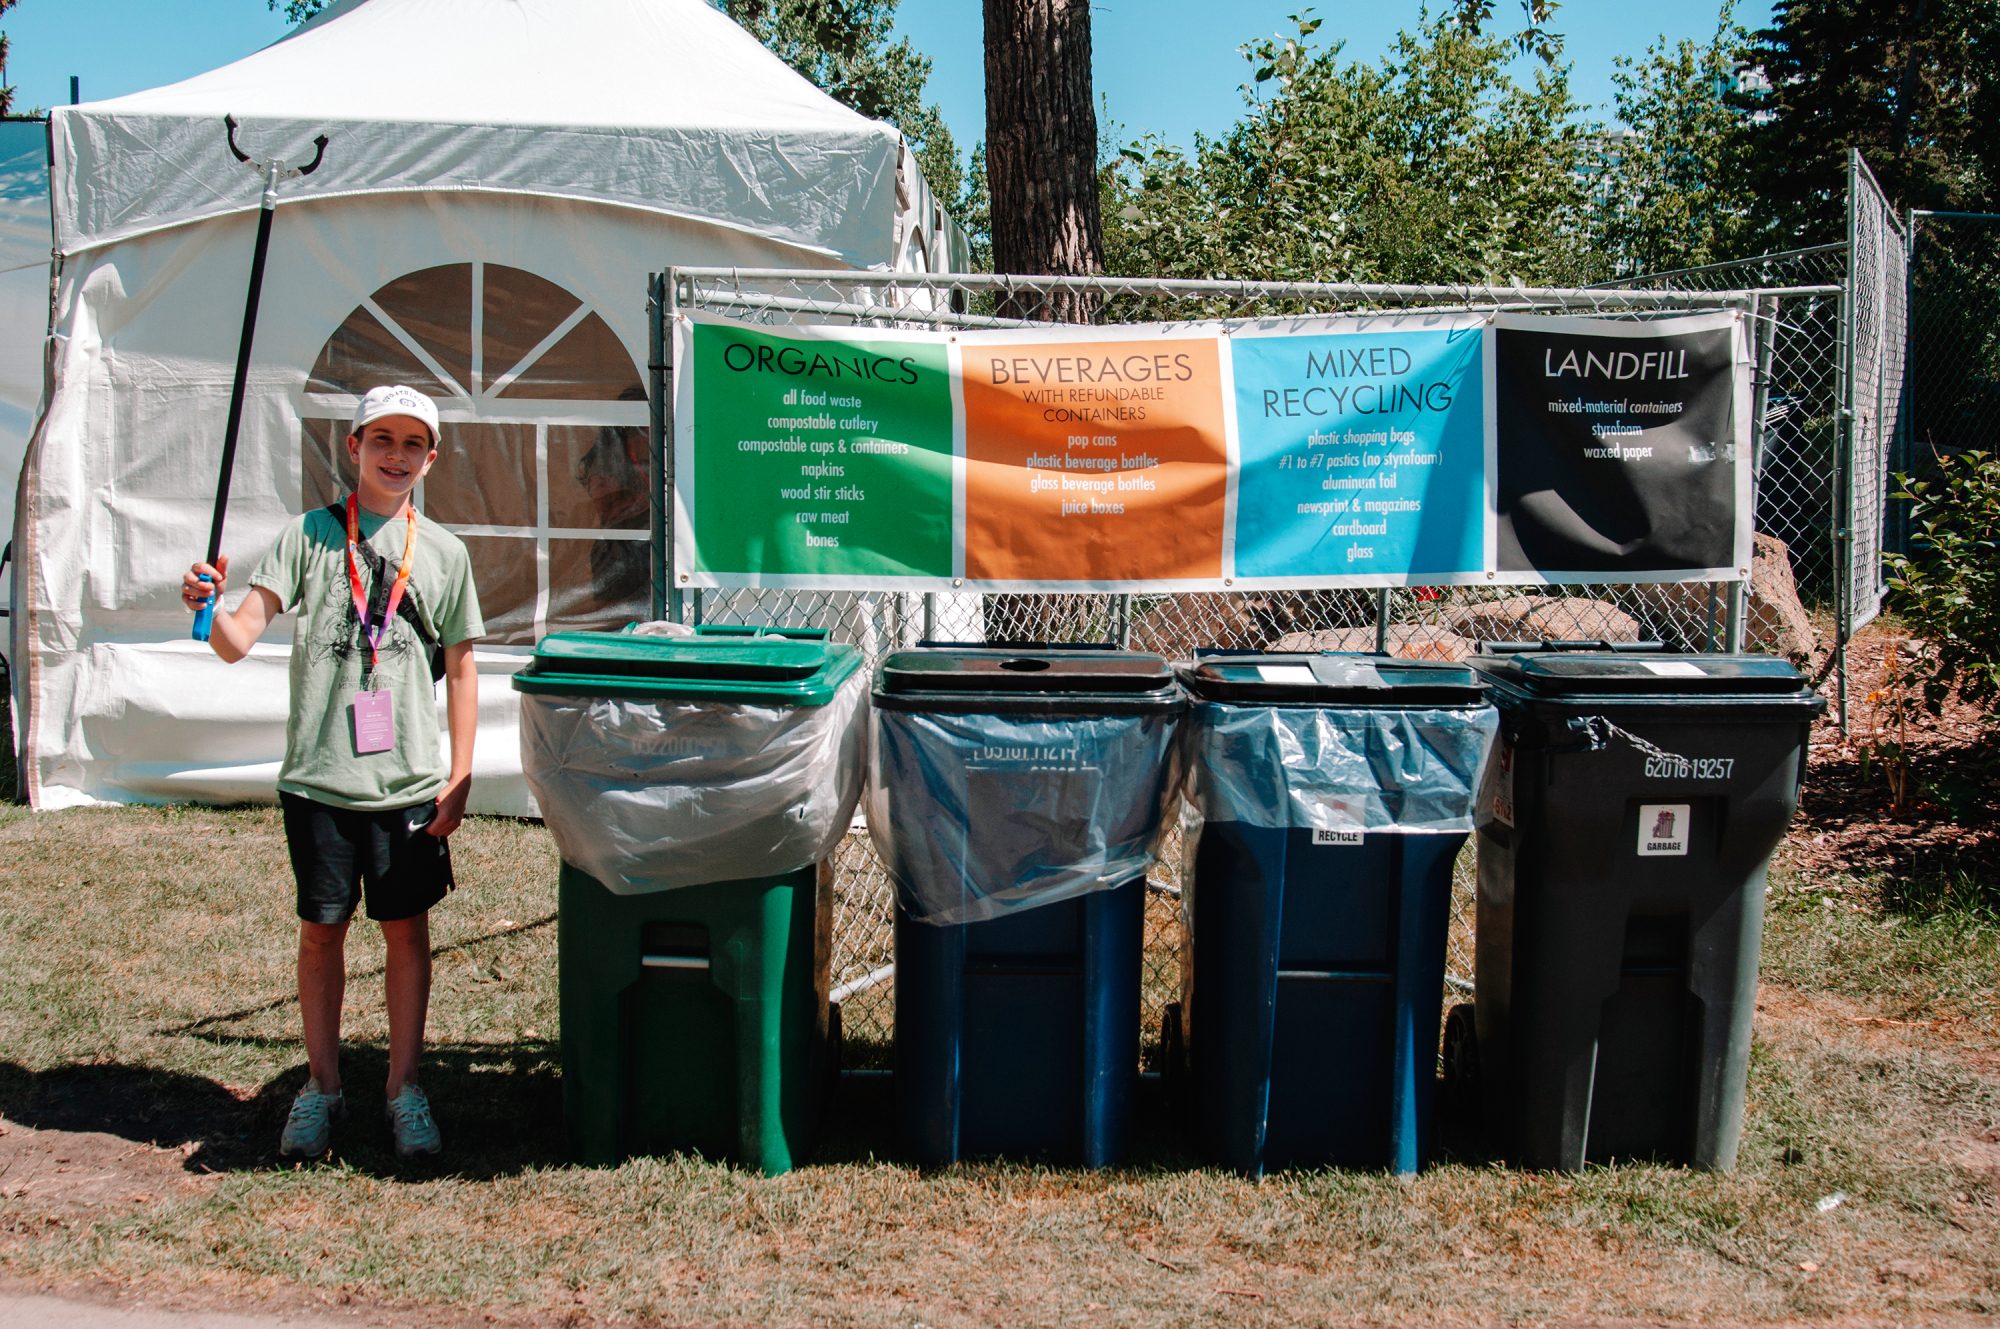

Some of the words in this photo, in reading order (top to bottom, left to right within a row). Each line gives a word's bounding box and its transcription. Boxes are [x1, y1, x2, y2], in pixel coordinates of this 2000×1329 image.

[724, 344, 918, 384] ORGANICS
[991, 354, 1192, 384] BEVERAGES
[1307, 348, 1411, 378] MIXED
[1545, 349, 1688, 380] LANDFILL
[783, 390, 796, 405] all
[801, 390, 826, 406] food
[830, 395, 861, 408] waste
[1023, 389, 1063, 403] WITH
[1070, 387, 1164, 402] REFUNDABLE
[1264, 382, 1452, 417] RECYCLING
[1044, 407, 1145, 422] CONTAINERS
[1548, 397, 1626, 413] mixed-material
[1630, 401, 1682, 413] containers
[768, 414, 836, 432] compostable
[840, 415, 878, 434] cutlery
[1592, 420, 1642, 439] styrofoam
[738, 436, 806, 455] compostable
[810, 441, 834, 456] cups
[838, 440, 846, 454] &
[851, 440, 908, 454] containers
[1068, 435, 1088, 449] pop
[1093, 435, 1117, 446] cans
[1308, 430, 1339, 448] plastic
[1343, 429, 1387, 446] shopping
[1390, 427, 1415, 444] bags
[1279, 455, 1292, 469] #1
[1297, 456, 1307, 469] to
[1310, 454, 1324, 468] #7
[1327, 453, 1359, 468] pastics
[1363, 453, 1380, 467] (no
[1384, 450, 1442, 468] styrofoam)
[1584, 443, 1620, 458] waxed
[1623, 445, 1652, 461] paper
[802, 460, 844, 479] napkins
[1027, 452, 1062, 470] plastic
[1066, 453, 1118, 472] beverage
[1121, 453, 1158, 469] bottles
[1031, 475, 1058, 493] glass
[1062, 475, 1114, 494] beverage
[1118, 476, 1155, 491] bottles
[1322, 474, 1375, 490] aluminum
[1379, 473, 1396, 489] foil
[781, 484, 810, 499] wood
[814, 486, 831, 500] stir
[835, 484, 864, 500] sticks
[1062, 498, 1087, 517] juice
[1091, 498, 1124, 514] boxes
[1297, 499, 1348, 516] newsprint
[1352, 498, 1361, 512] &
[1365, 498, 1421, 515] magazines
[796, 511, 817, 523] raw
[821, 511, 849, 523] meat
[1333, 520, 1387, 535] cardboard
[806, 531, 839, 548] bones
[1347, 542, 1373, 562] glass
[1318, 830, 1358, 841] RECYCLE
[1647, 842, 1681, 851] GARBAGE
